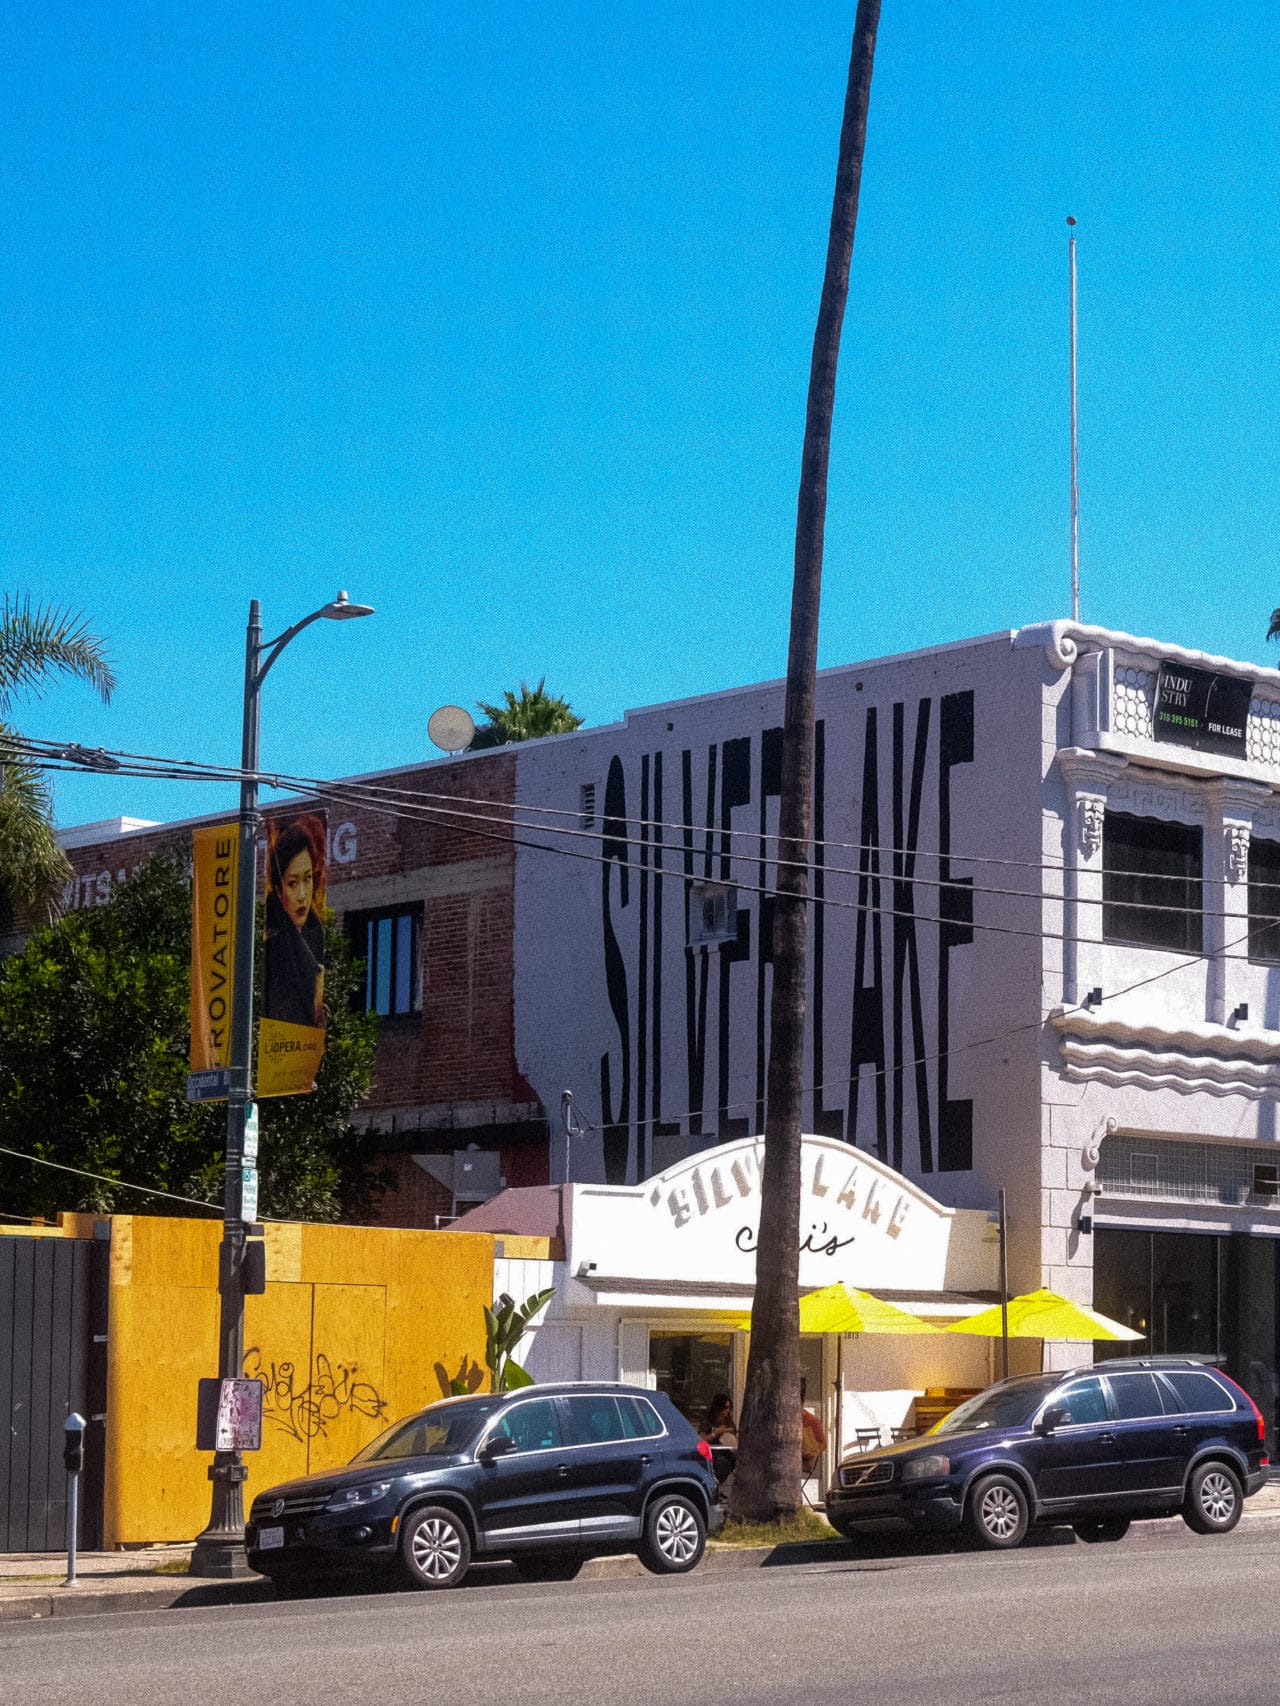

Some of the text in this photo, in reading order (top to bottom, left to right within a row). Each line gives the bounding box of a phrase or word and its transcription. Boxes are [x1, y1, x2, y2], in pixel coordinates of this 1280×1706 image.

[1159, 711, 1171, 722] 310
[1208, 722, 1243, 738] FOR LEASE
[207, 837, 232, 1068] ROVATORE
